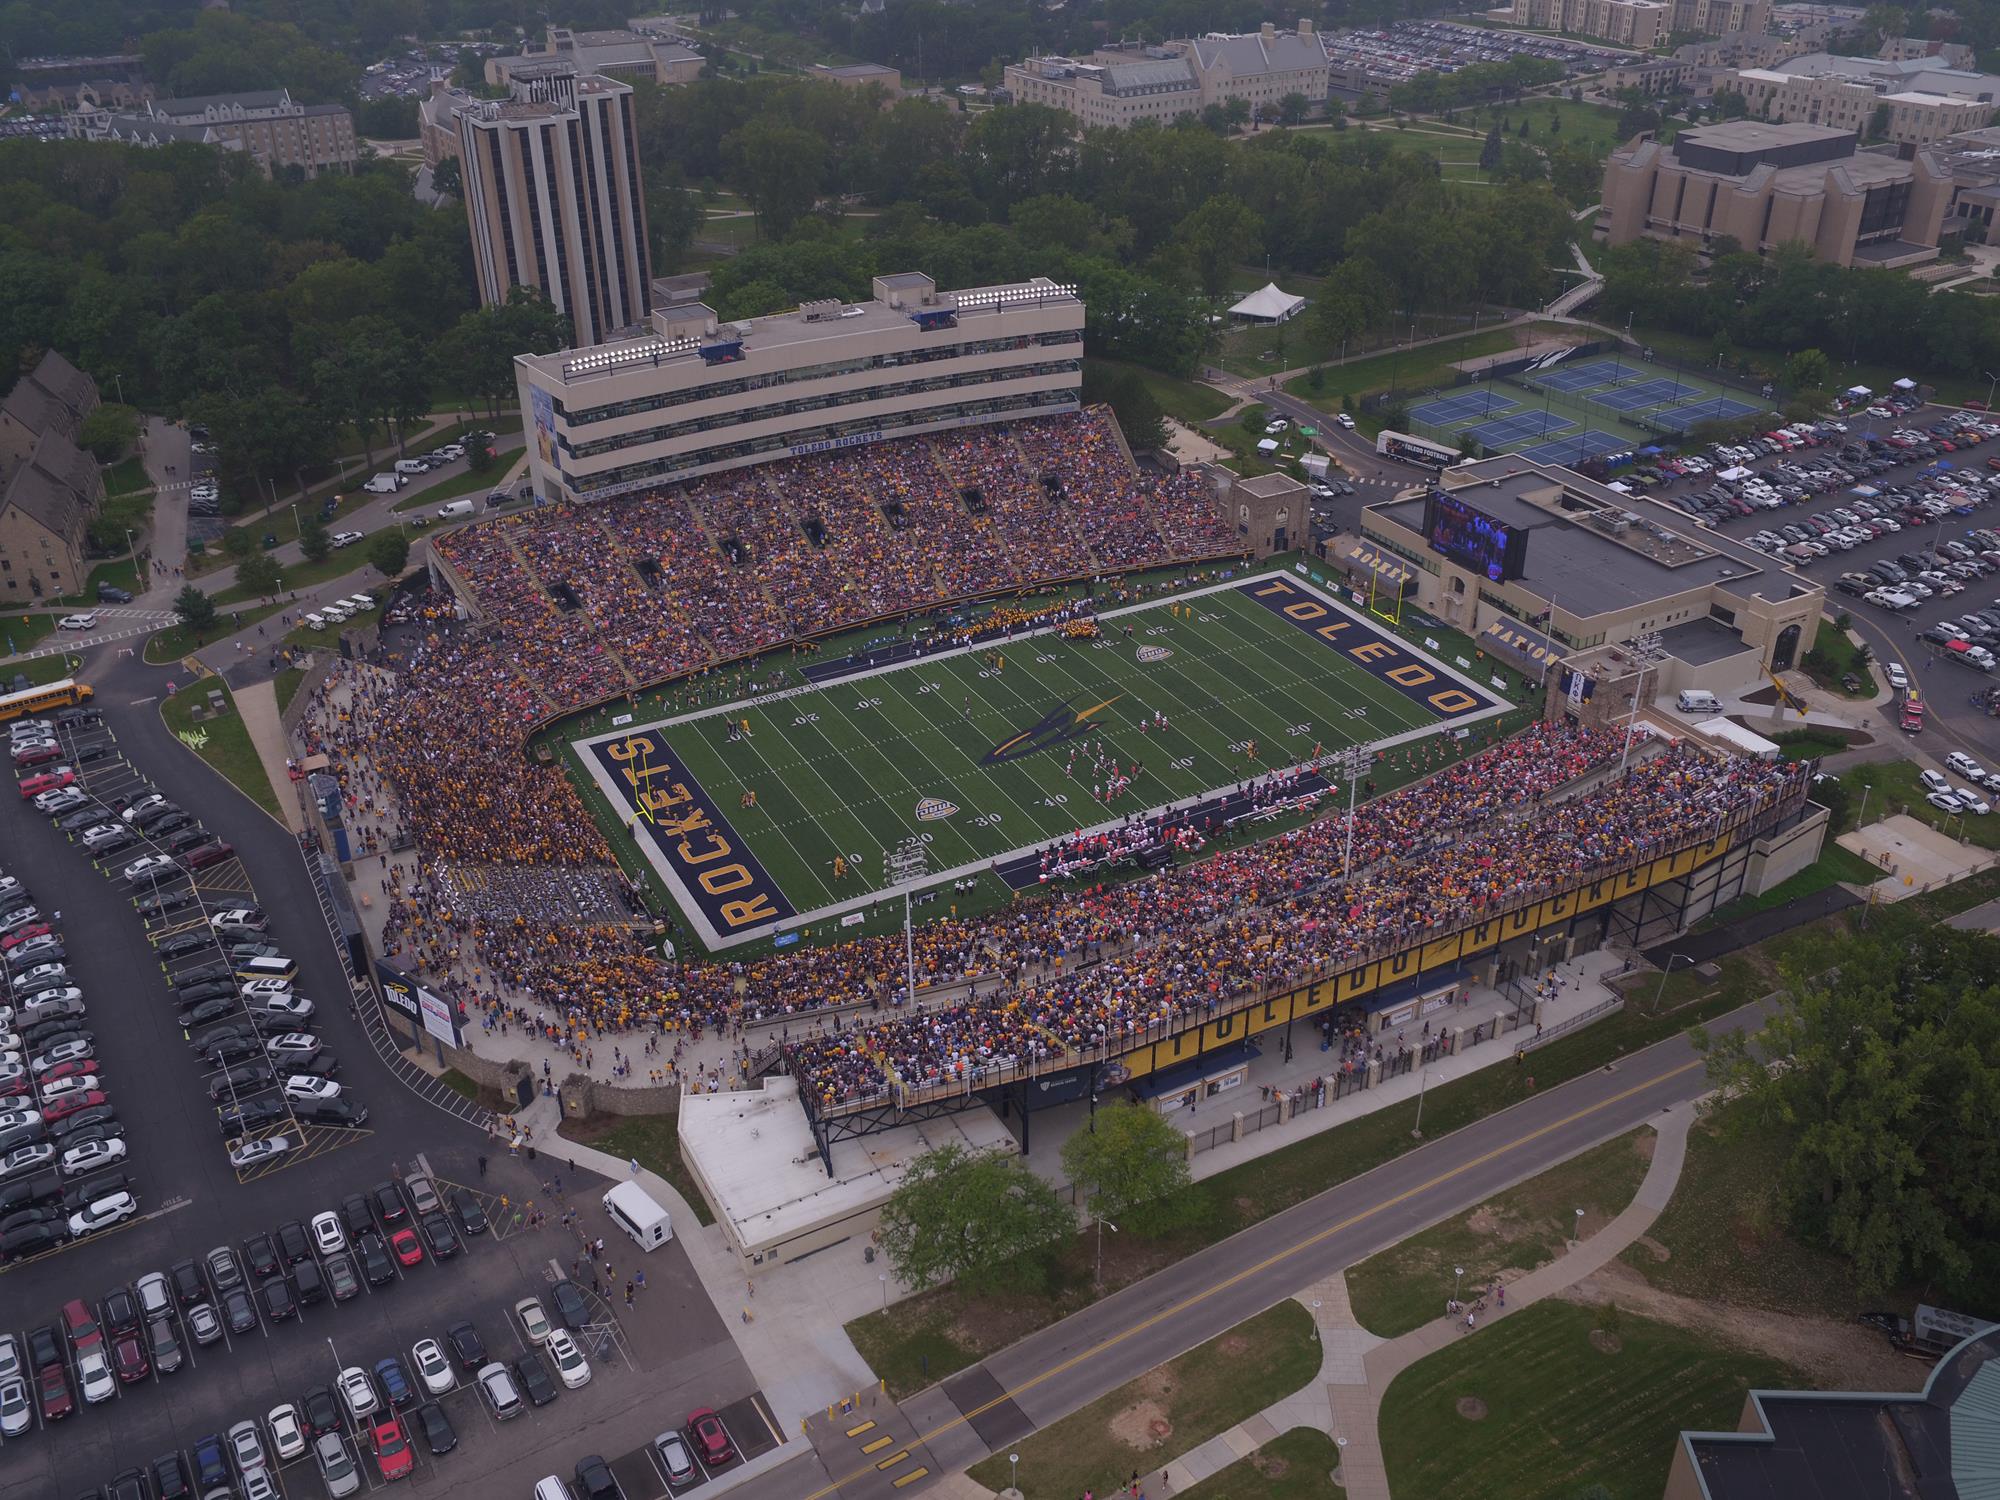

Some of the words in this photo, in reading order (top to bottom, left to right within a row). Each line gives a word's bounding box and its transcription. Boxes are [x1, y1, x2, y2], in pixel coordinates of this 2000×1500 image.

[790, 441, 831, 456] TOLEDO
[836, 431, 882, 447] ROCKETS
[1405, 443, 1424, 454] TOLEDO
[1423, 448, 1449, 462] FOOTBALL
[523, 510, 536, 522] TO
[1350, 546, 1412, 584] ROCKET
[1198, 612, 1221, 624] 10
[1145, 625, 1170, 637] 20
[1092, 638, 1115, 650] 30
[1254, 581, 1477, 713] TOLEDO
[1486, 622, 1561, 667] NATION
[1035, 653, 1059, 665] 40
[919, 682, 942, 693] 40
[751, 693, 781, 706] BOWL
[858, 697, 883, 709] 30
[794, 712, 821, 725] 20
[1342, 706, 1366, 720] 10
[1285, 723, 1311, 737] 20
[1169, 757, 1194, 771] 40
[1043, 793, 1069, 808] 40
[974, 812, 1002, 828] 30
[607, 737, 778, 927] ROCKETS
[905, 832, 934, 848] 20
[1473, 839, 1715, 945] ROCKETS
[383, 985, 418, 1015] TOLEDO
[1173, 950, 1407, 1056] TOLEDO
